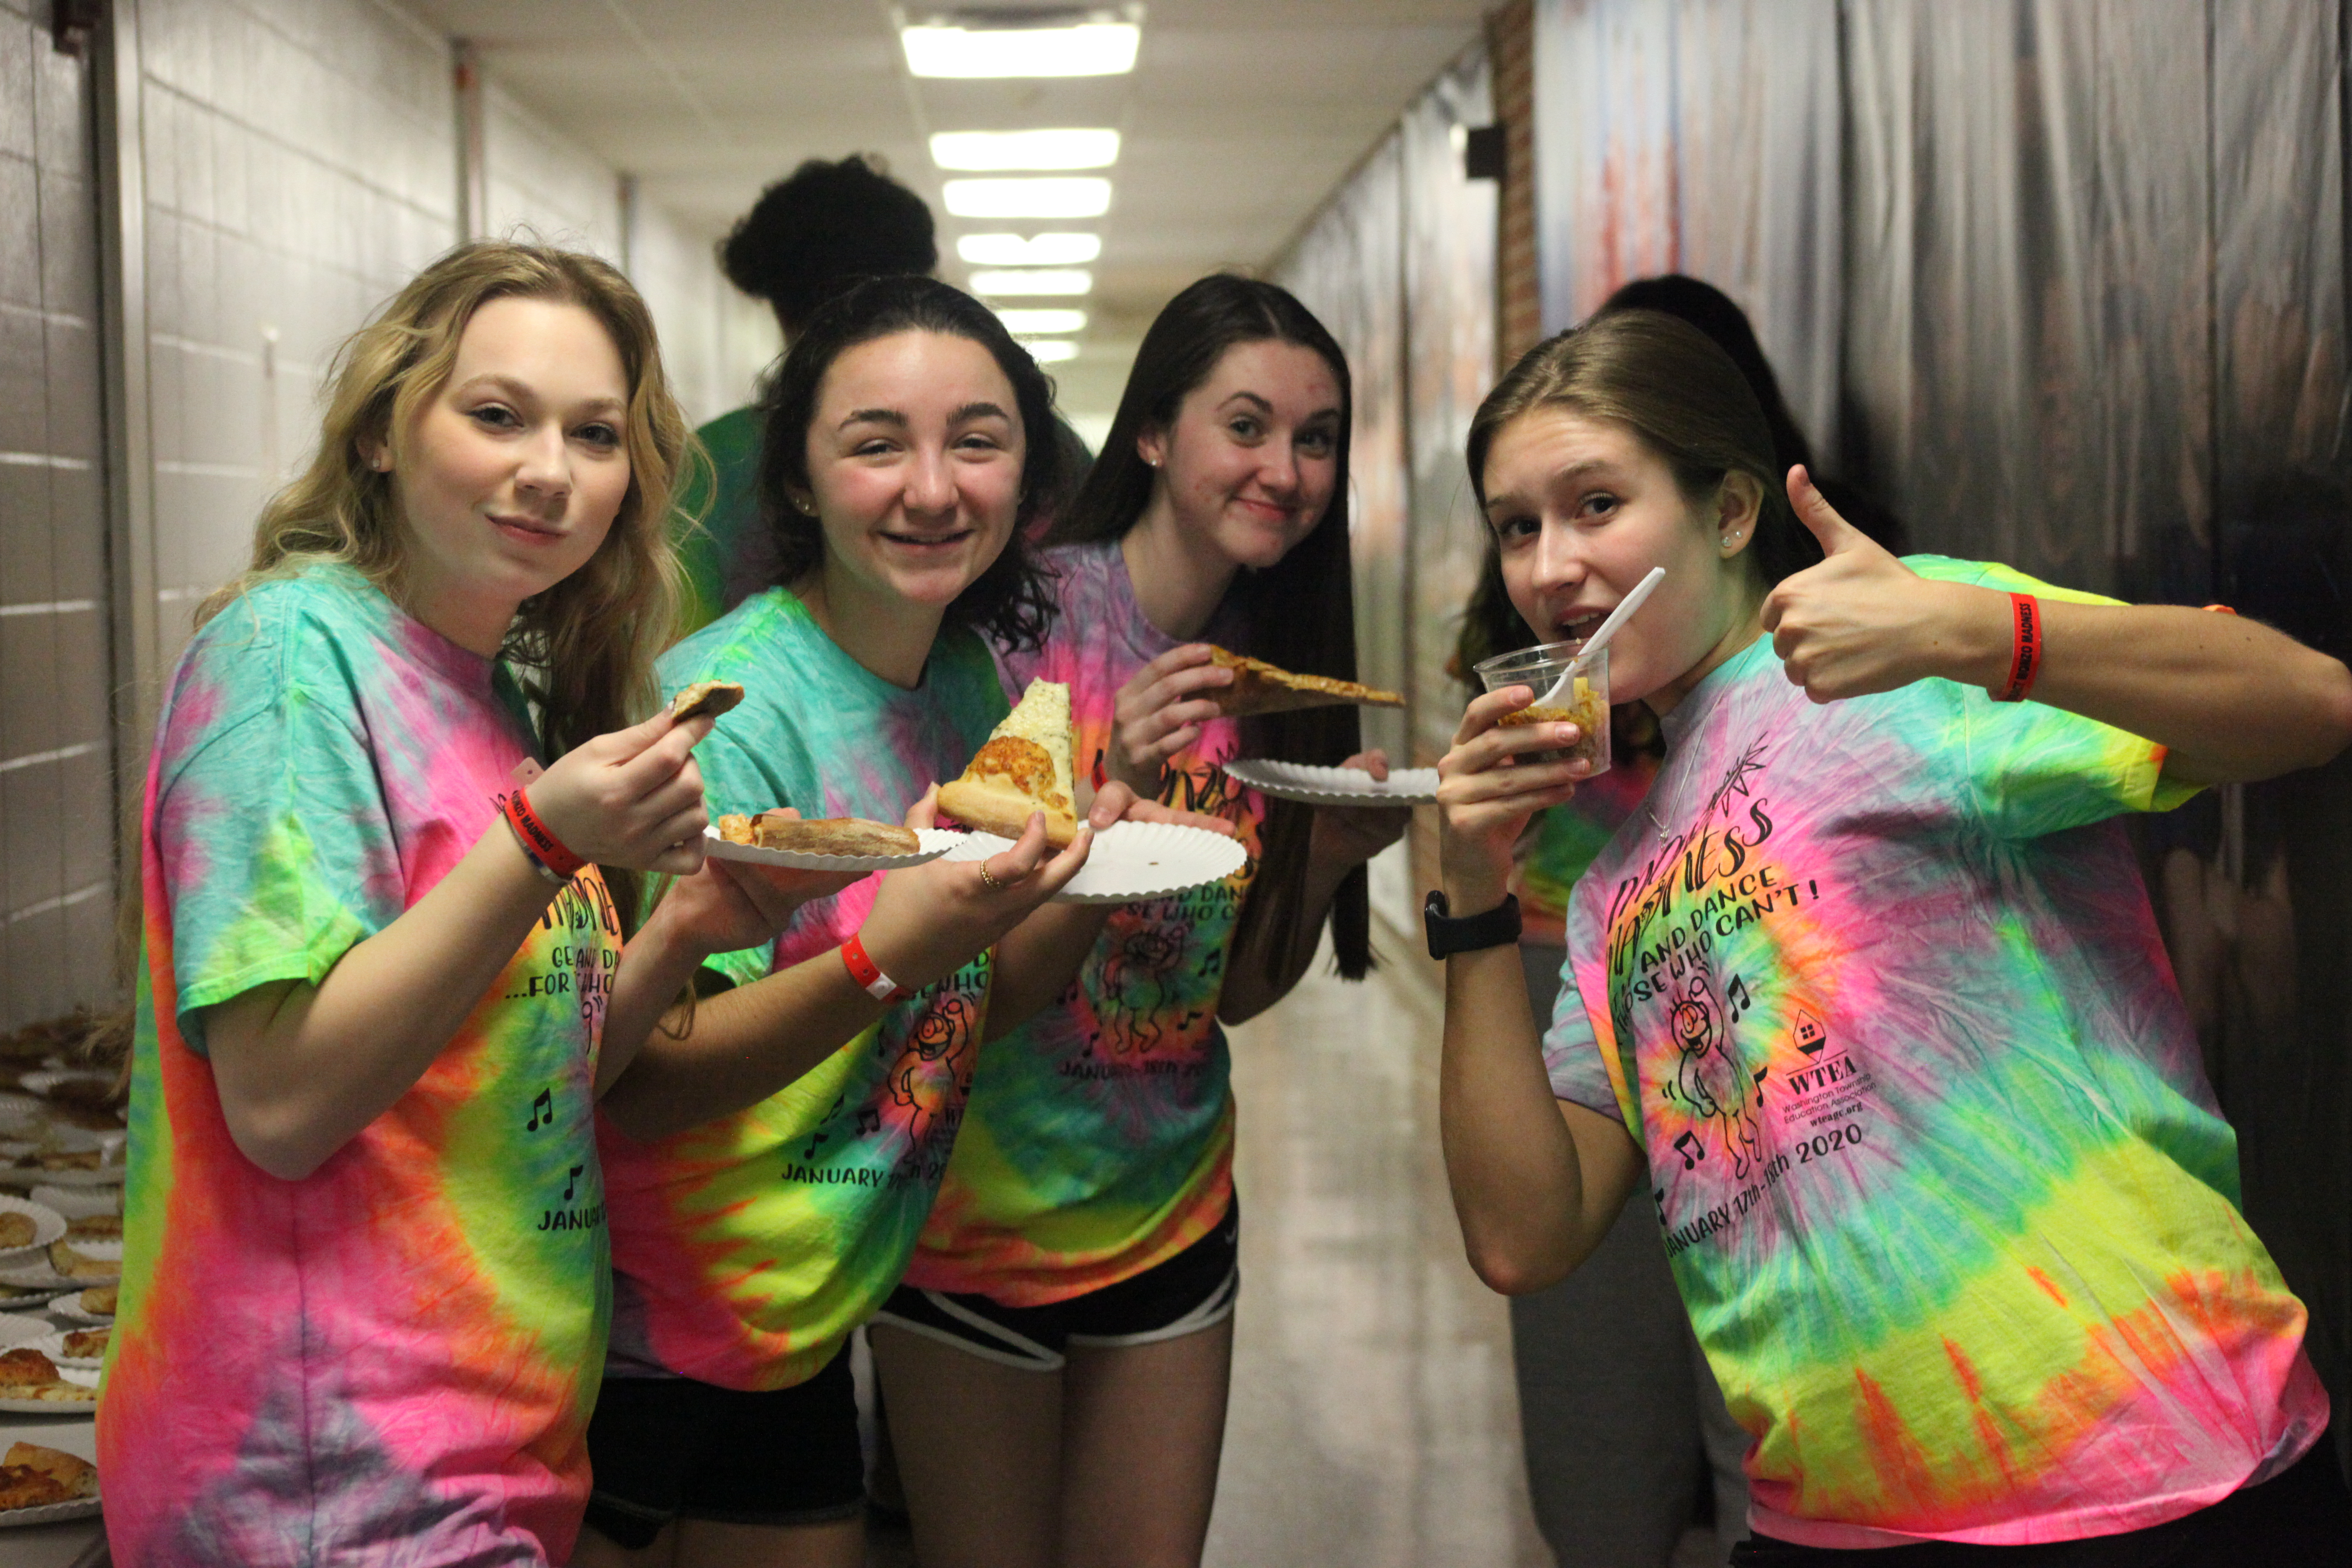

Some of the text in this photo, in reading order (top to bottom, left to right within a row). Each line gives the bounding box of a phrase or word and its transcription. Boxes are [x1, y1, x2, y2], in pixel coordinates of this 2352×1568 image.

[2019, 603, 2033, 643] MADNESS
[521, 815, 554, 852] MADNESS
[1202, 885, 1243, 902] DAN
[1641, 866, 1777, 974] AND DANCE
[1670, 931, 1712, 980] WHO
[1782, 1073, 1871, 1114] Washington Township
[1788, 1056, 1857, 1095] WTEA
[1784, 1082, 1876, 1124] Education Association
[1810, 1101, 1863, 1127] wteagc.org
[1795, 1123, 1862, 1164] 2020
[782, 1163, 886, 1188] JANUARY
